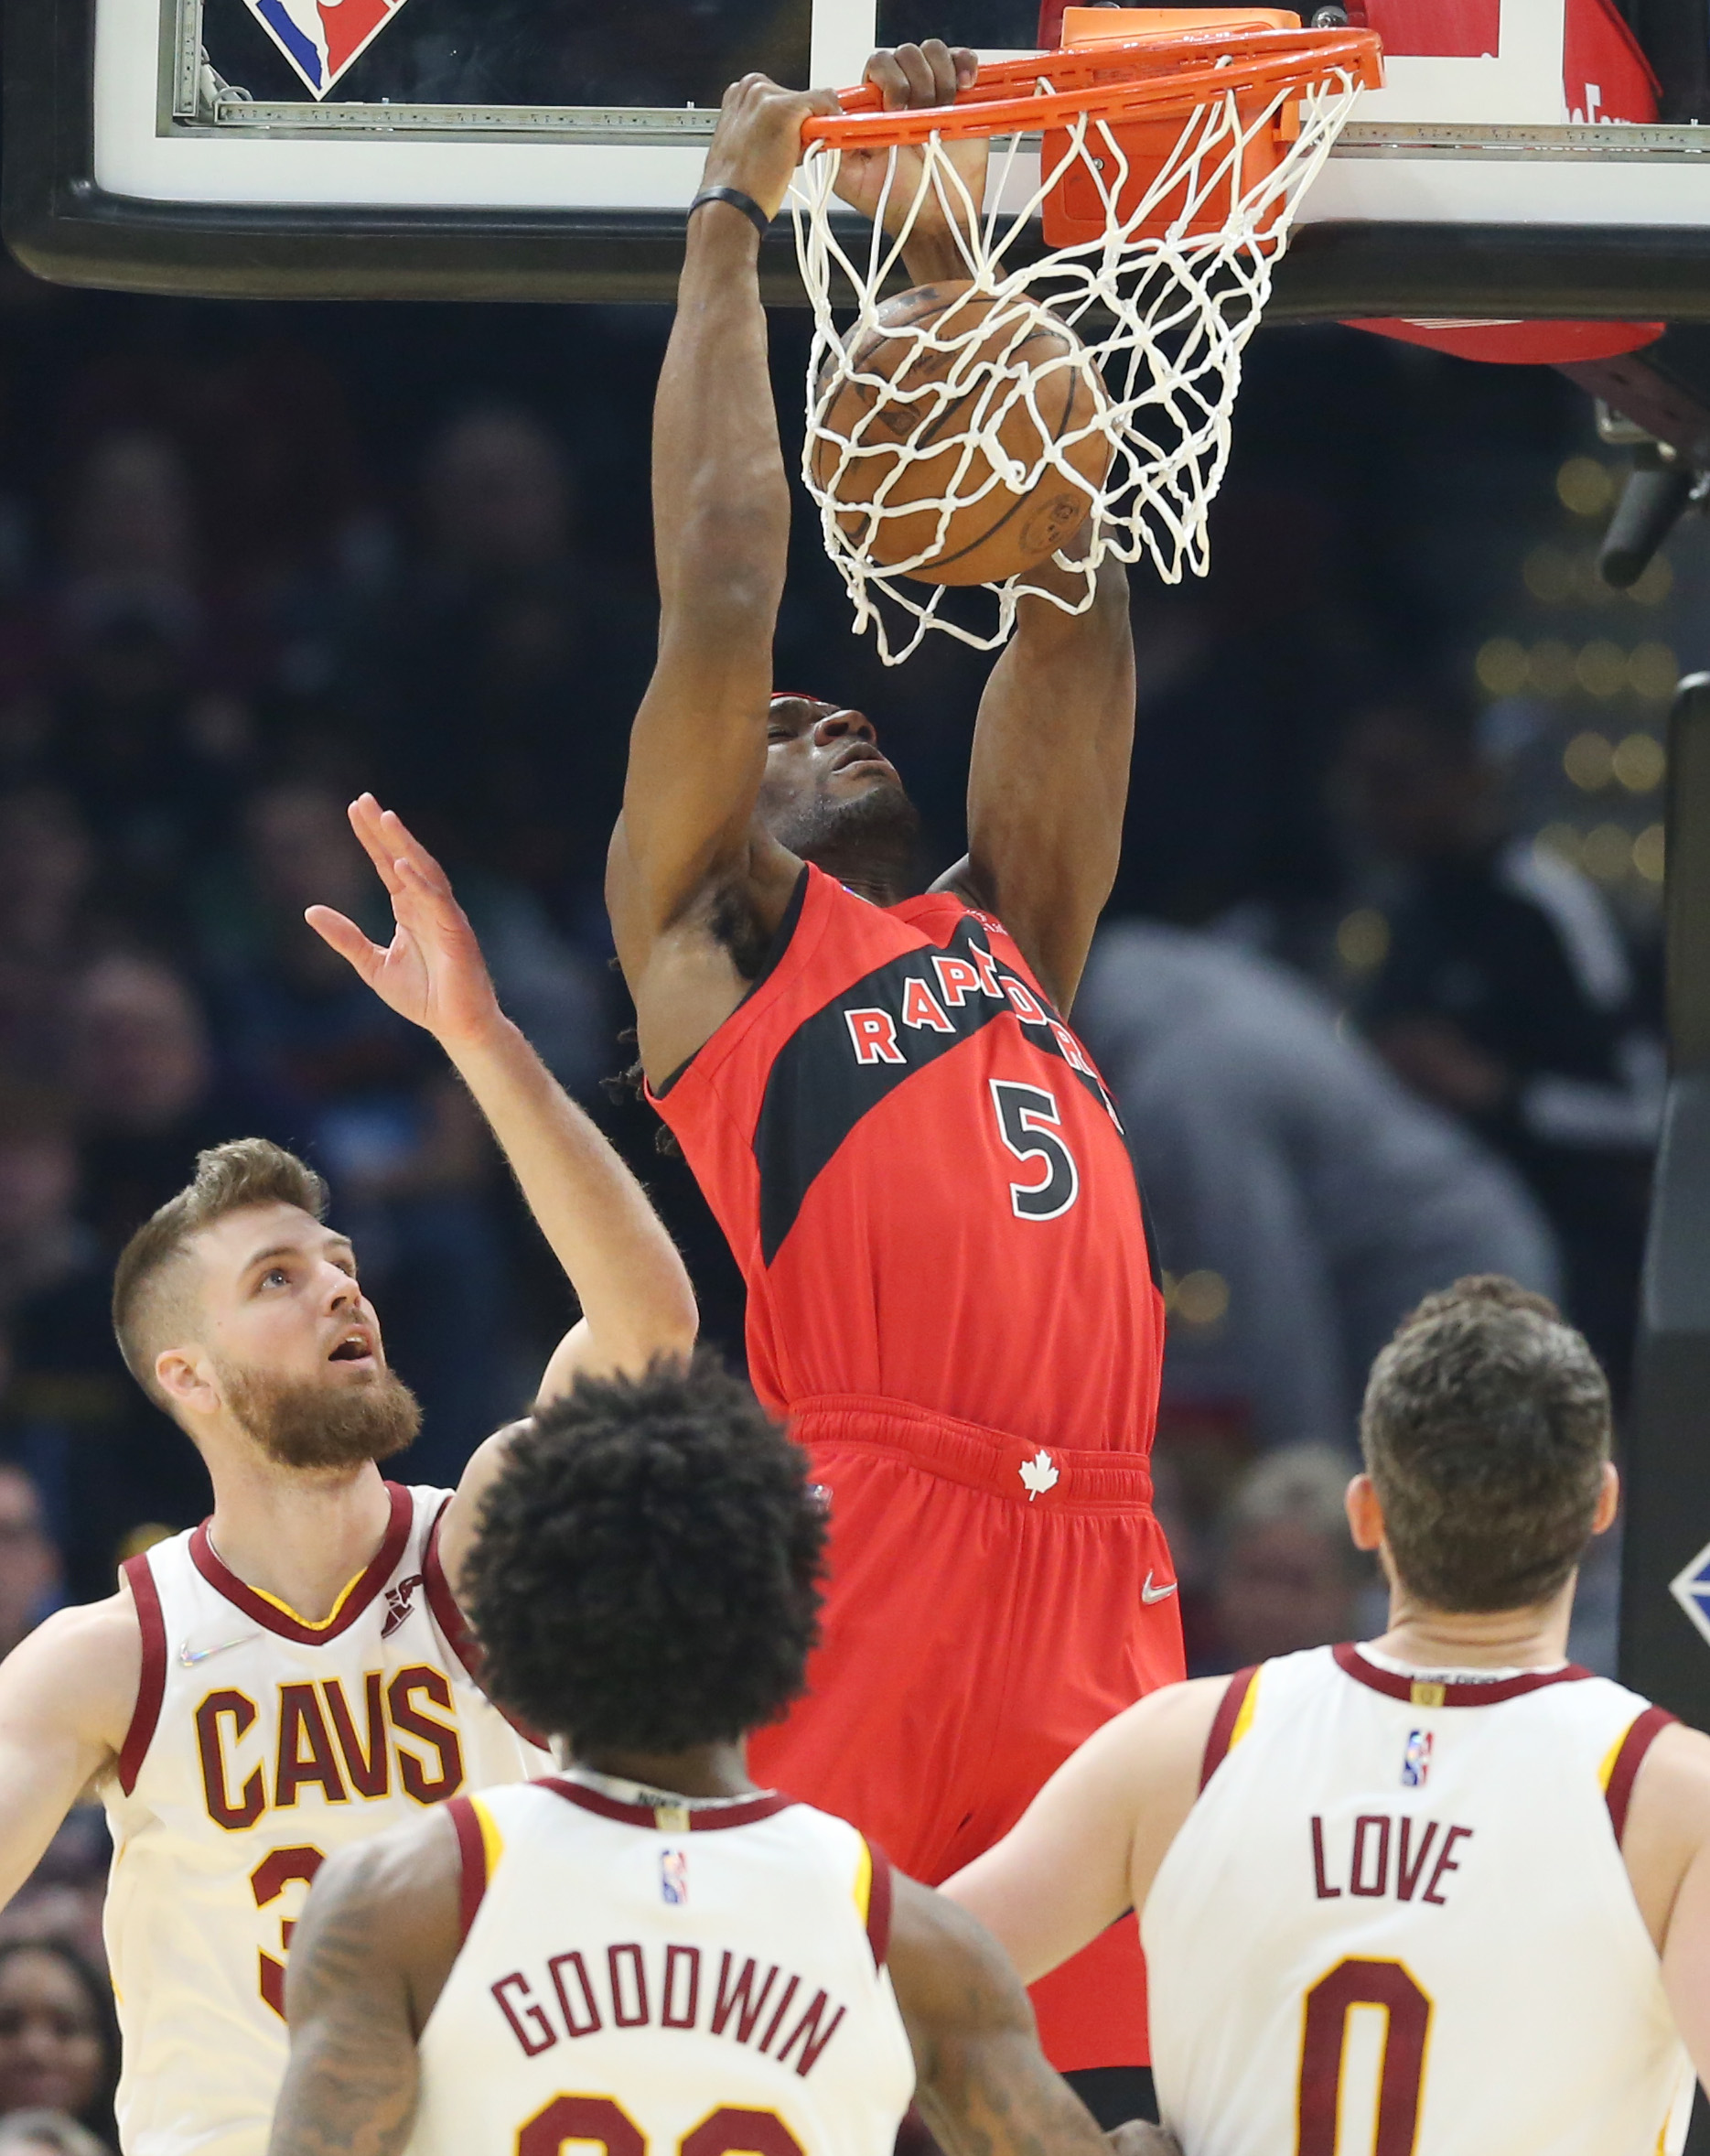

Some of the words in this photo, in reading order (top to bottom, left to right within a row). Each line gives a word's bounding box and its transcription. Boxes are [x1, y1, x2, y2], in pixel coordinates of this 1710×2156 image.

[988, 1078, 1080, 1222] 5
[193, 1662, 466, 1832] CAVS
[1311, 1814, 1474, 1906] LOVE
[490, 1943, 846, 2078] GOODWIN
[1294, 1954, 1435, 2156] 0
